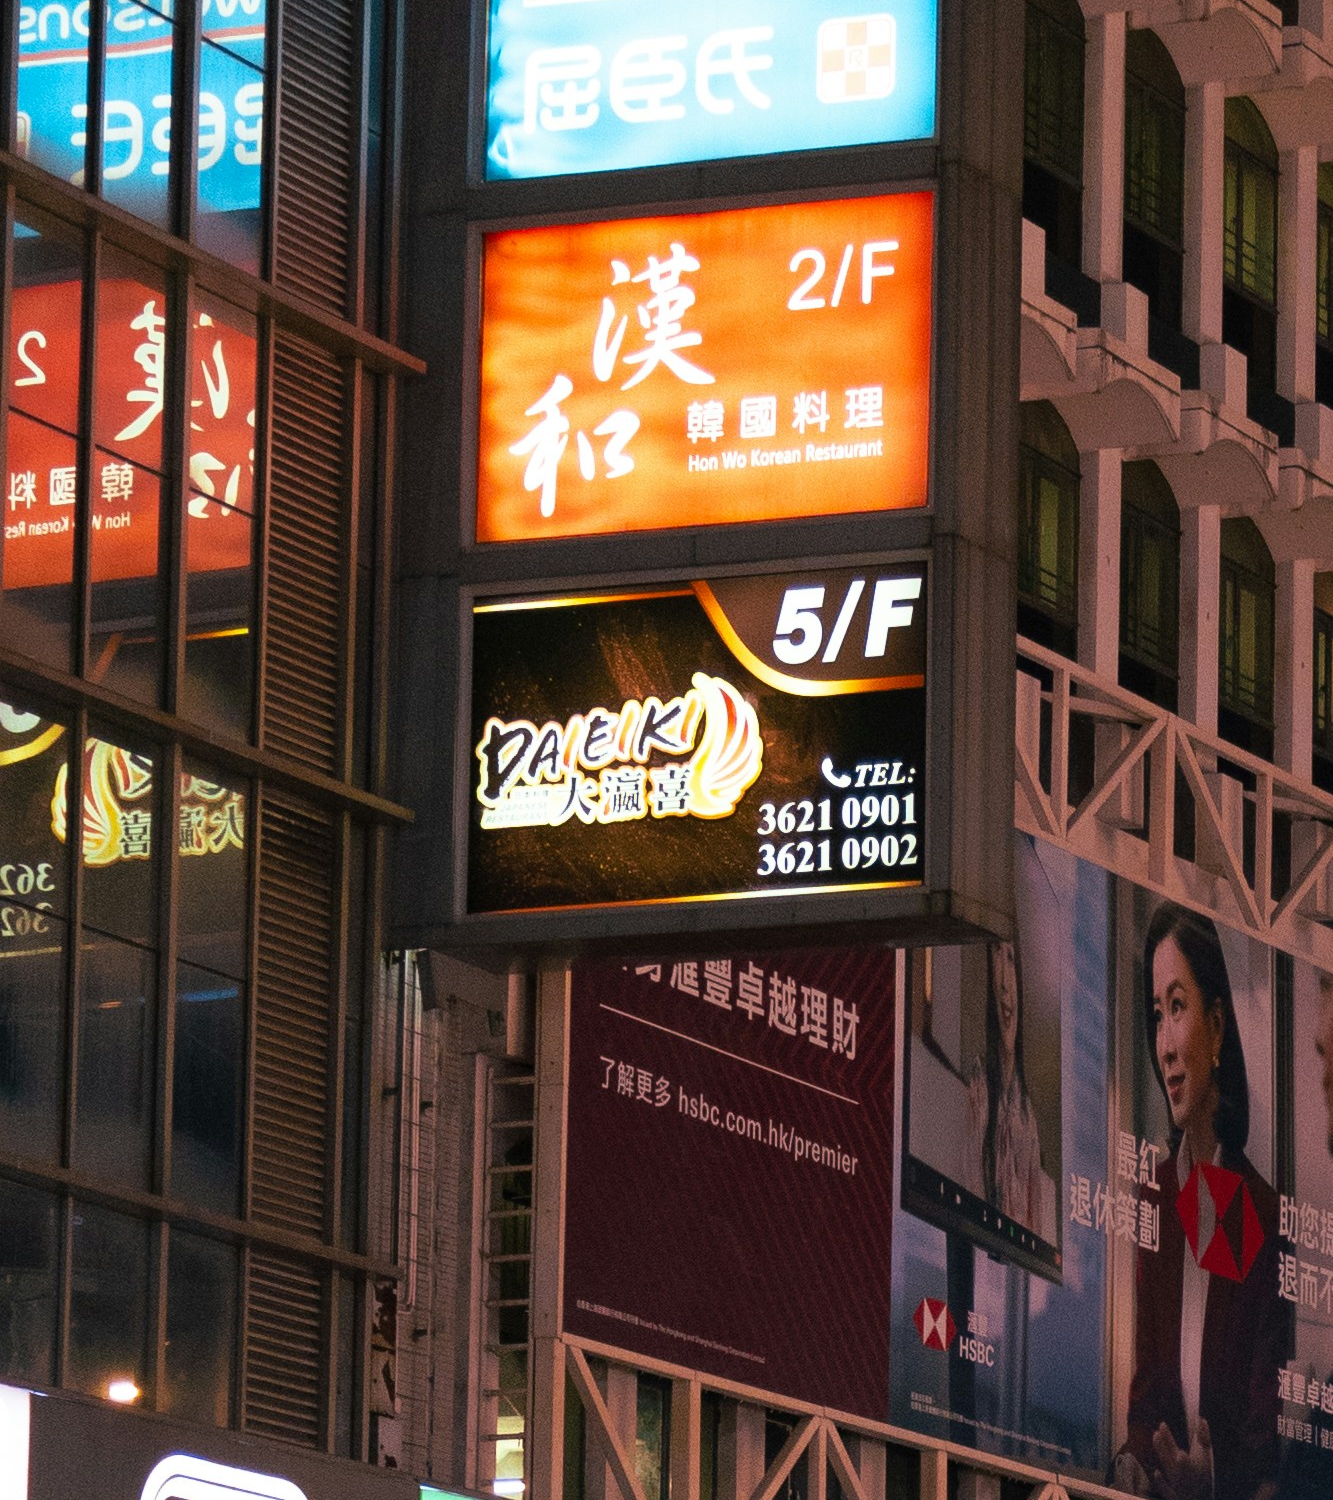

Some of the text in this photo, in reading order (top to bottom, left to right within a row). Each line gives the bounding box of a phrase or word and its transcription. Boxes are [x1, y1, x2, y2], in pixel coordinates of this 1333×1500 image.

[522, 25, 776, 134] 屈臣氏
[787, 240, 901, 312] 2/F
[686, 385, 885, 445] 韓國料理
[687, 438, 884, 474] Hon Wo Korean Restaurant
[772, 577, 923, 667] 5/F
[852, 759, 917, 789] TEL:
[757, 793, 918, 838] 3621 0901
[755, 833, 919, 878] 3621 0902
[620, 958, 862, 1062] 滙豐卓越理財
[599, 1055, 860, 1177] 了解更多 hsbc.com.hk/premier
[1118, 1130, 1161, 1192] 最紅
[1069, 1172, 1161, 1254] 退休策劃
[958, 1334, 996, 1368] HSBC
